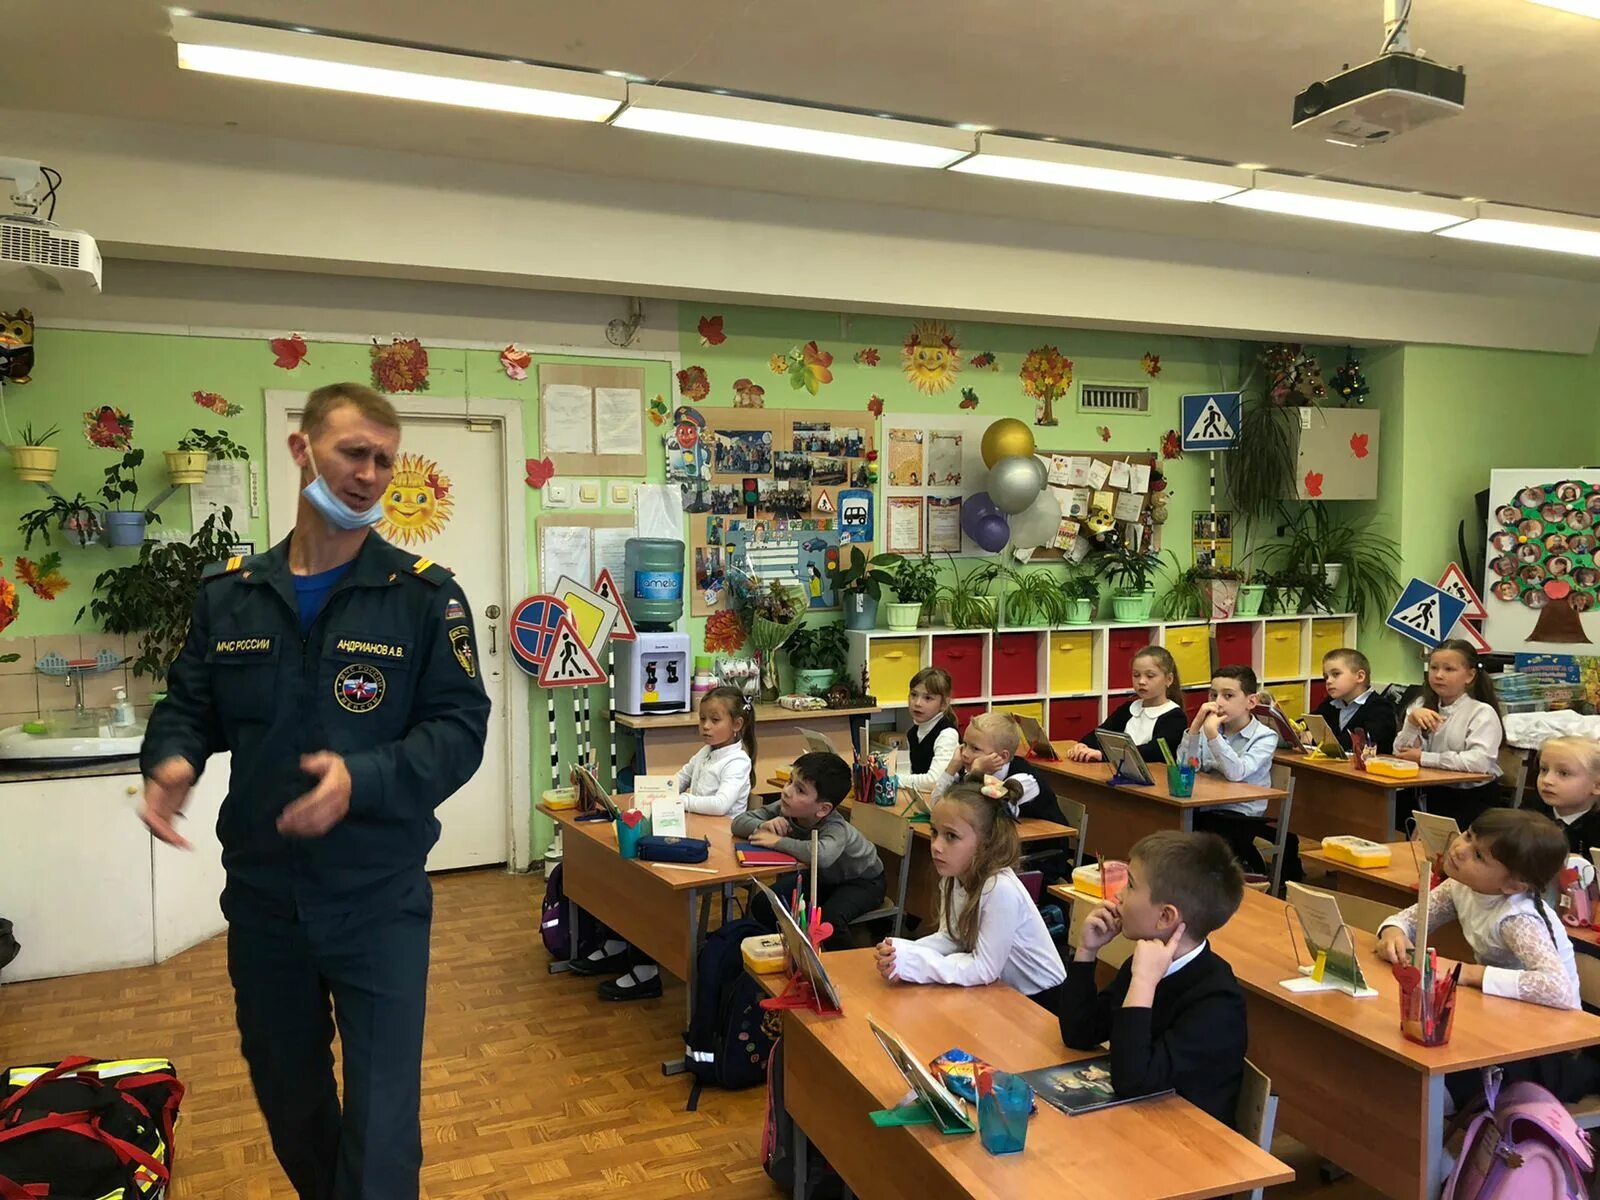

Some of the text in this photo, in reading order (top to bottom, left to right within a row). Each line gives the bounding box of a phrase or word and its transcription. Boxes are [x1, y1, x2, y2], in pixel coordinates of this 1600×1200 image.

[216, 638, 271, 653] МЧС РОССИИ
[336, 639, 388, 655] АНДРИАНОВ
